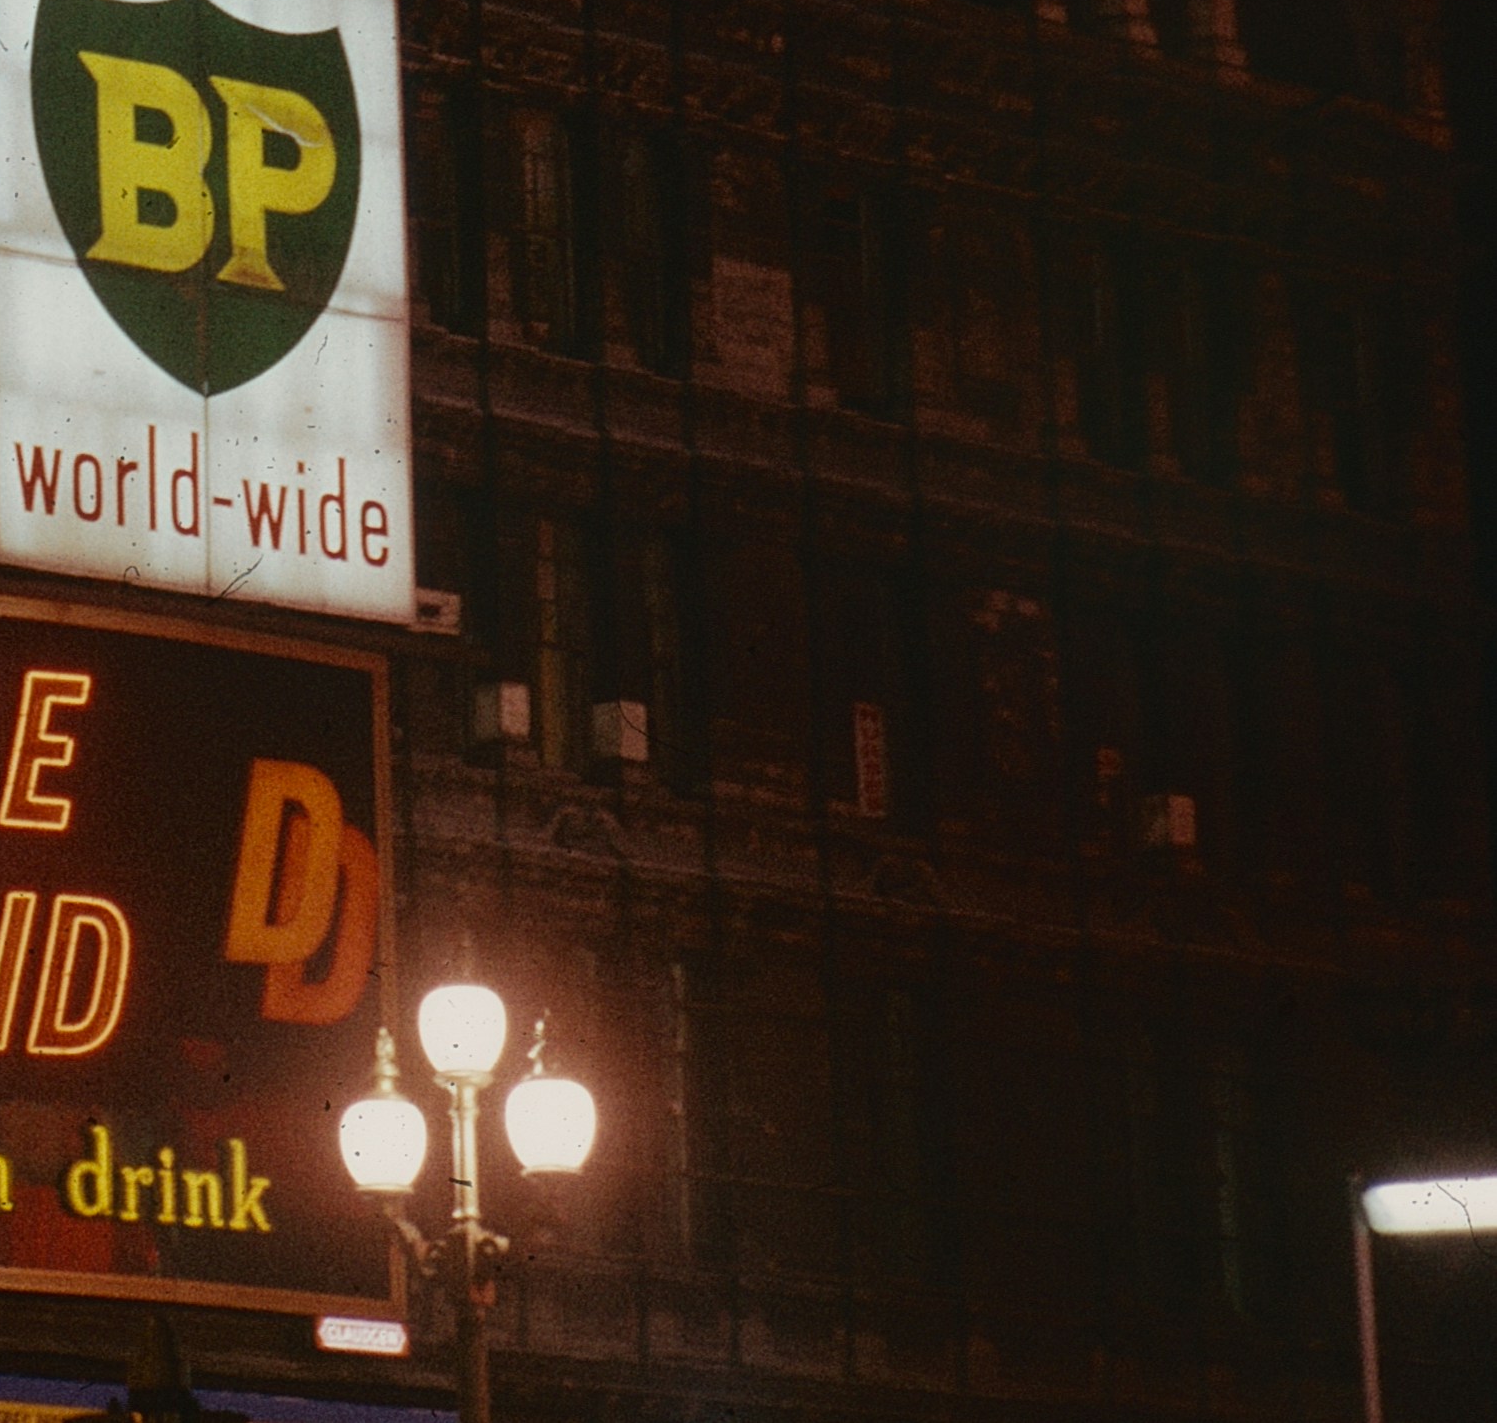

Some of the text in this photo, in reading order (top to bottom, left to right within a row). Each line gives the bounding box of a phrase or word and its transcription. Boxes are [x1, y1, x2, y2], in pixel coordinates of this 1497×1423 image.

[77, 50, 338, 292] BP
[13, 424, 392, 568] world-wide
[65, 1124, 272, 1233] drink
